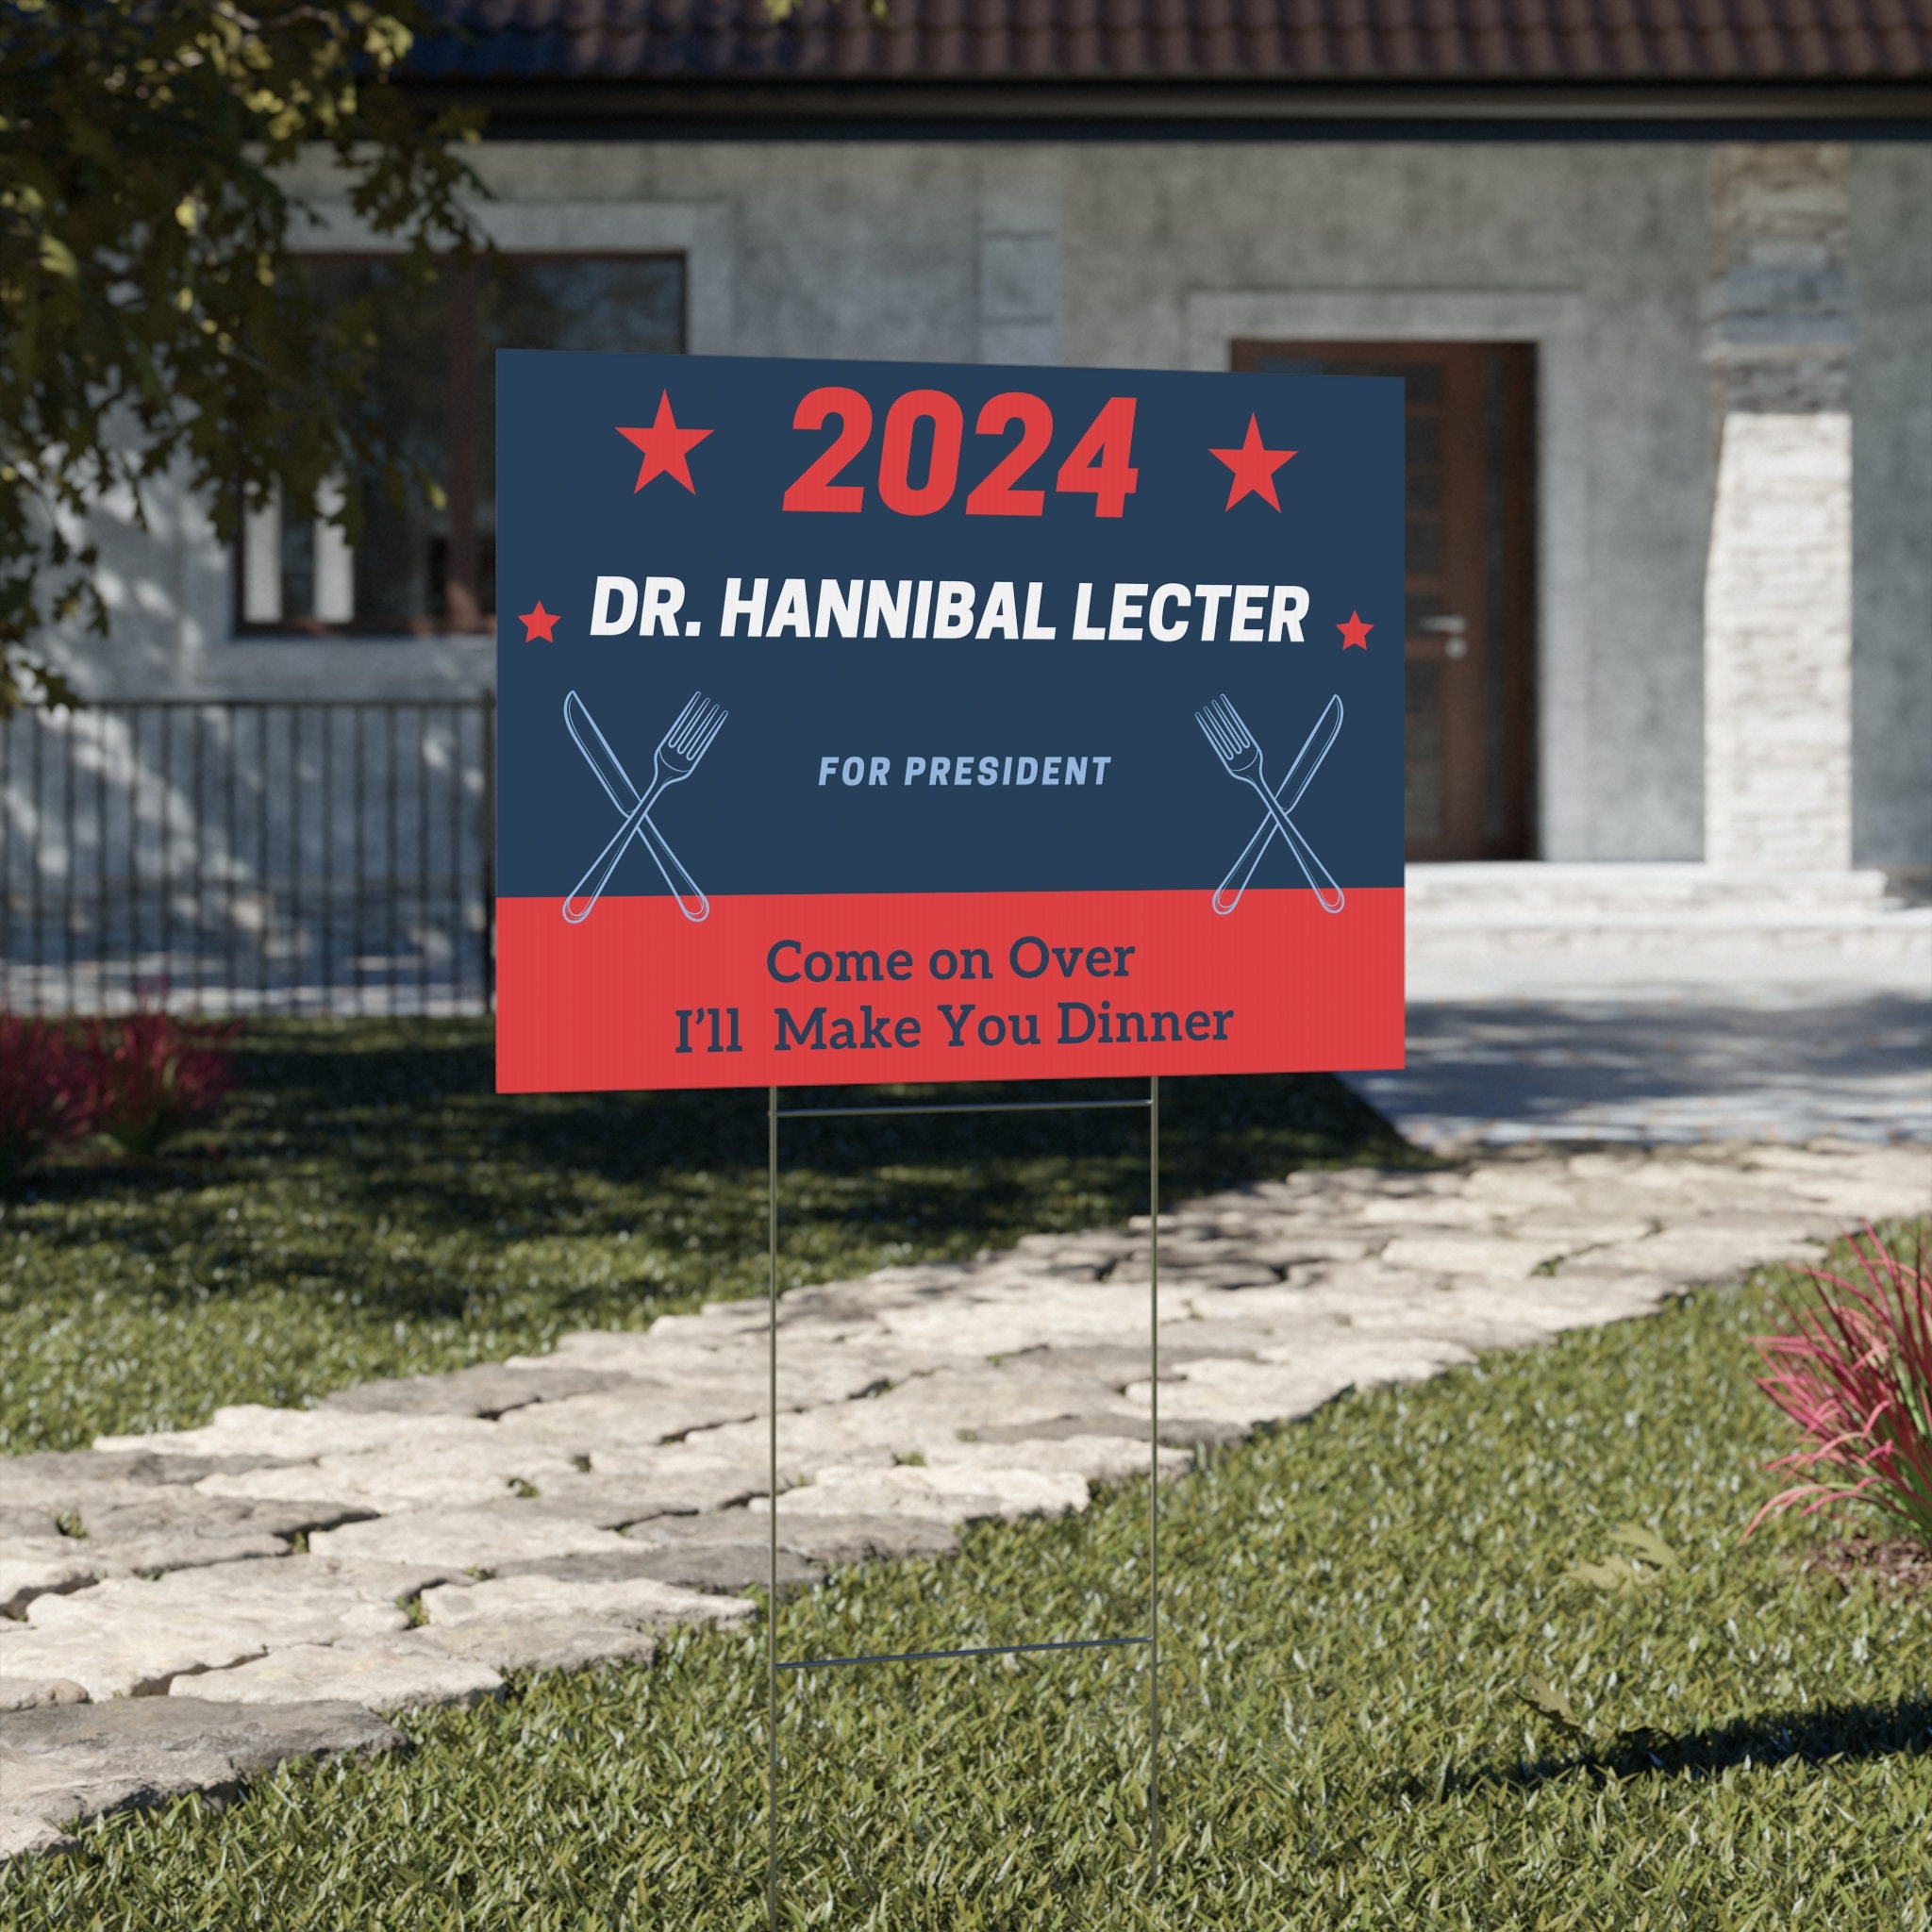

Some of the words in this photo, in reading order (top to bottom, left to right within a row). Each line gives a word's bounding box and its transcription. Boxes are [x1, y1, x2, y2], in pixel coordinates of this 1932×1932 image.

[782, 386, 1139, 518] 2024
[590, 575, 702, 637] DR.
[720, 577, 1057, 641] HANNIBAL
[1072, 582, 1310, 642] LECTER
[818, 756, 891, 787] FOR
[904, 756, 1112, 787] PRESIDENT
[766, 939, 913, 984] Come
[928, 948, 994, 981] on
[1008, 935, 1136, 979] Over
[675, 1007, 743, 1054] I’ll
[774, 1005, 922, 1051] Make
[937, 1004, 1041, 1047] You
[1057, 1000, 1235, 1044] Dinner
